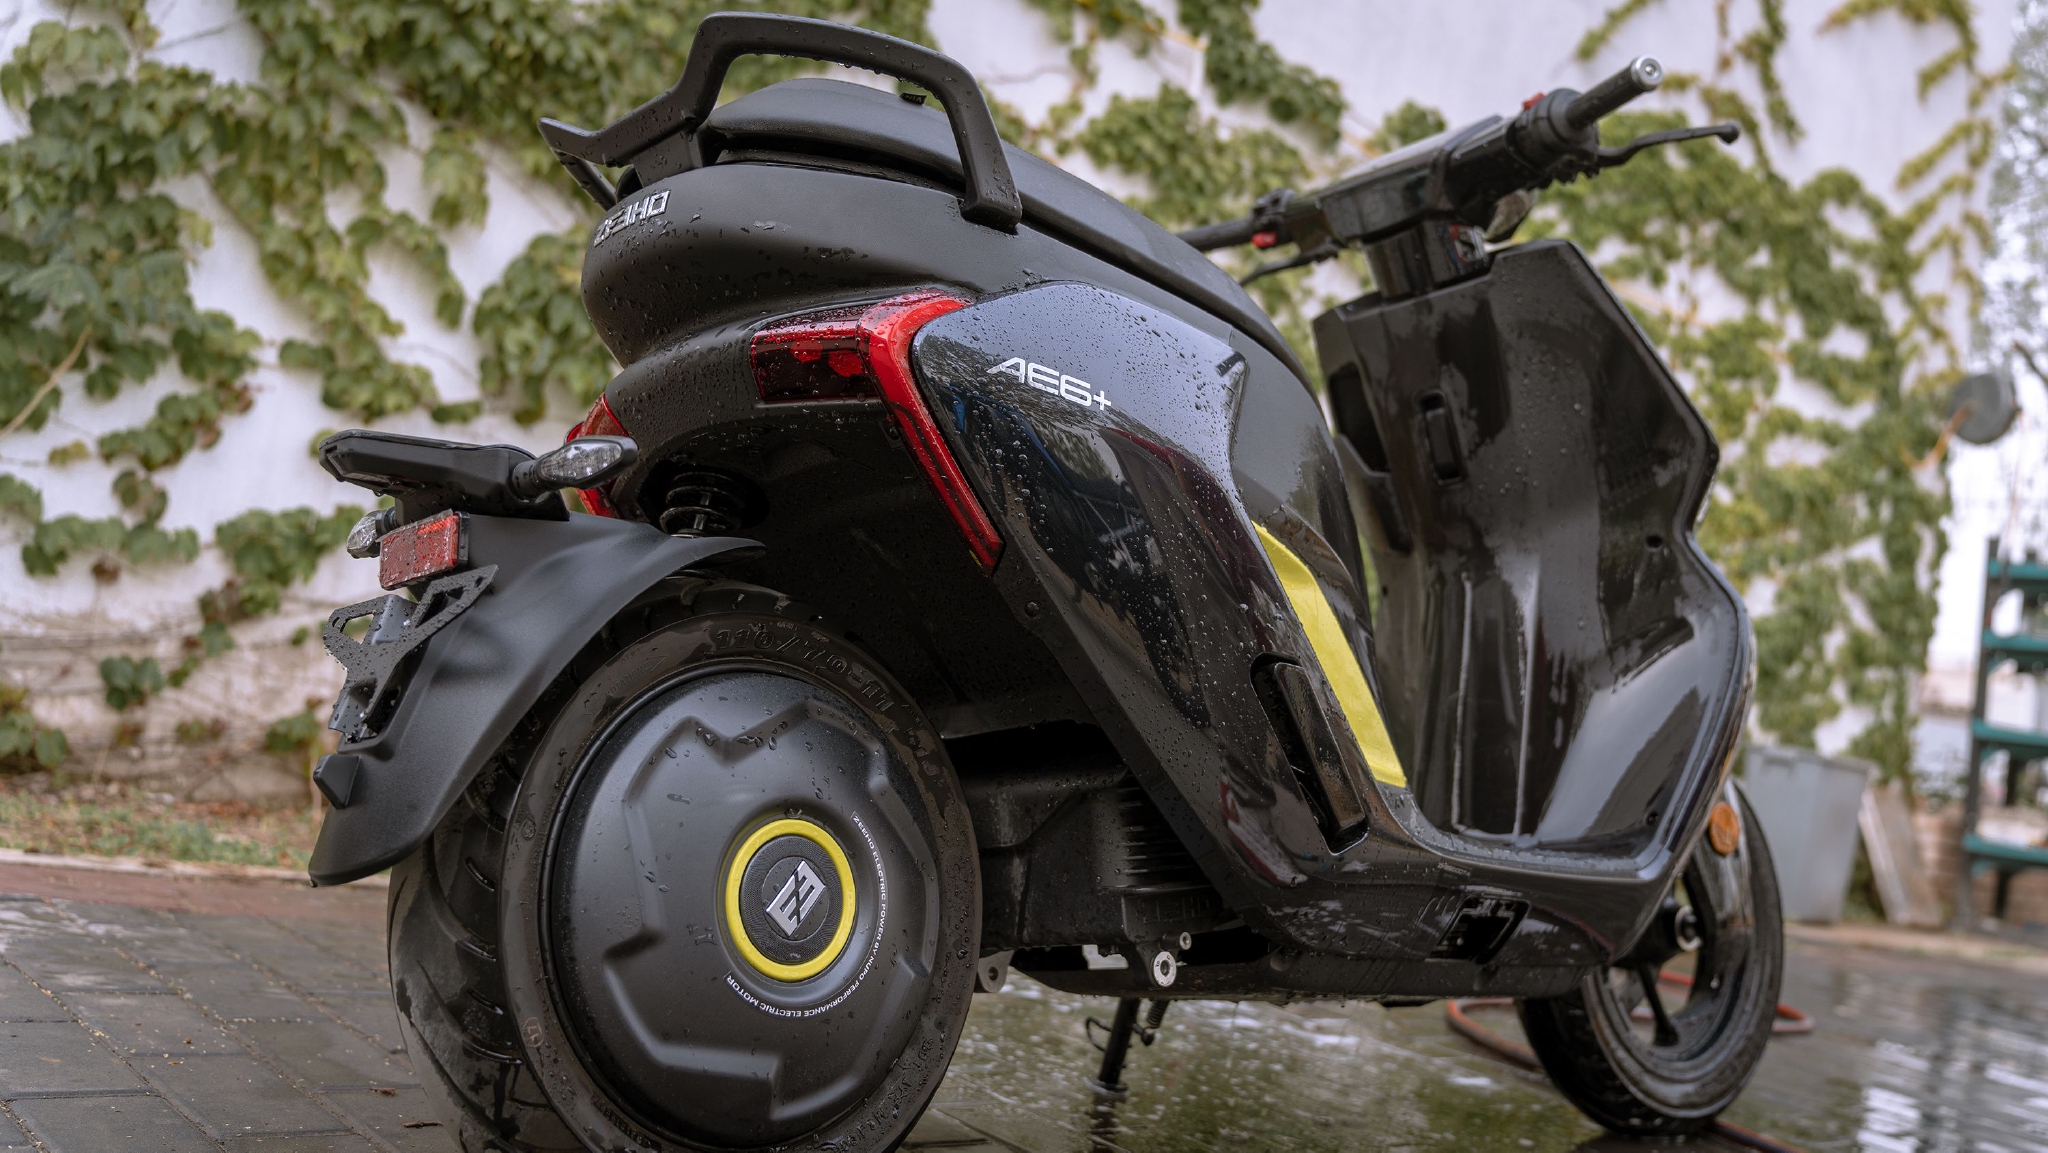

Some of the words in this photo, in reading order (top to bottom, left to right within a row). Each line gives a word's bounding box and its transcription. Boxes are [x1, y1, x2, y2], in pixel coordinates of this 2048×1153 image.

[986, 357, 1111, 411] AE6+
[716, 629, 895, 712] 110/70-11
[853, 815, 875, 849] ZEEHO
[872, 851, 887, 900] ELECTRIC
[877, 903, 886, 940] POWER
[872, 941, 880, 956] BY
[727, 975, 761, 1006] MOTOR
[804, 980, 860, 1017] PERFORMANCE
[759, 1002, 802, 1017] ELECTRIC
